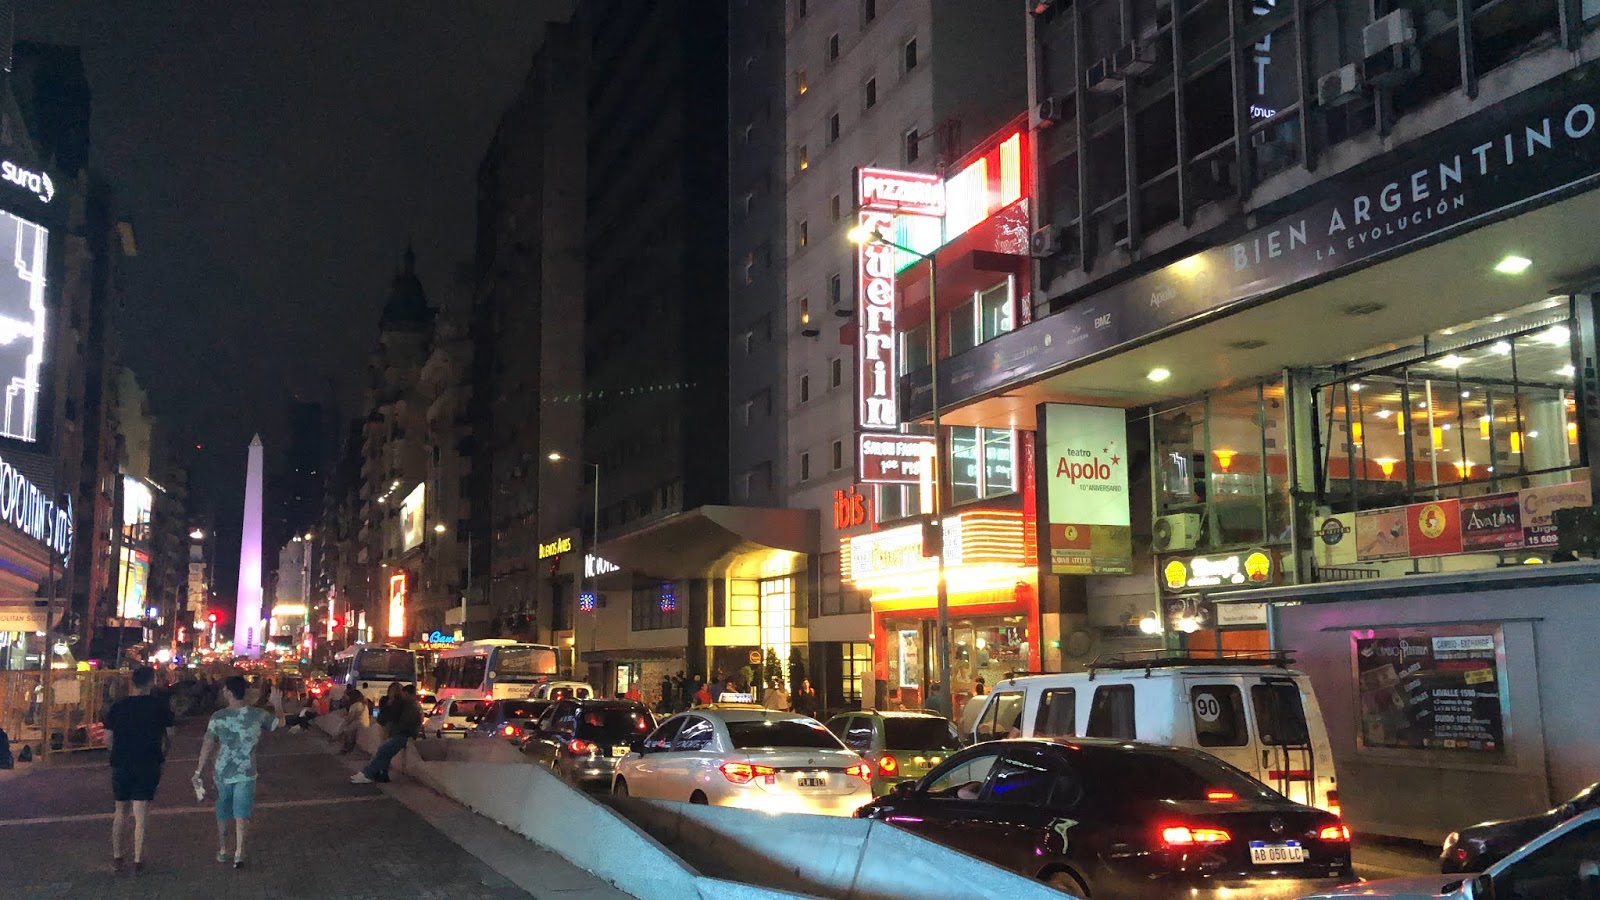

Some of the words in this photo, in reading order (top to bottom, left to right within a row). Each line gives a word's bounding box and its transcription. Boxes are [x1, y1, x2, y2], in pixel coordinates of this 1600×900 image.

[2, 161, 41, 193] sura
[1231, 220, 1307, 272] BIEN
[1328, 103, 1596, 235] ARGENTINO
[1316, 248, 1336, 260] LA
[1347, 193, 1465, 250] EVOLUCIÓN
[1095, 313, 1111, 329] BMZ
[1067, 448, 1091, 457] teatro
[1056, 457, 1111, 484] Apolo
[0, 456, 46, 541] OPOLITAN
[834, 486, 864, 529] ibis
[1529, 536, 1539, 544] 15
[1198, 700, 1217, 715] 90
[1255, 850, 1266, 860] AB
[1270, 849, 1286, 860] 050
[1290, 848, 1301, 859] LC
